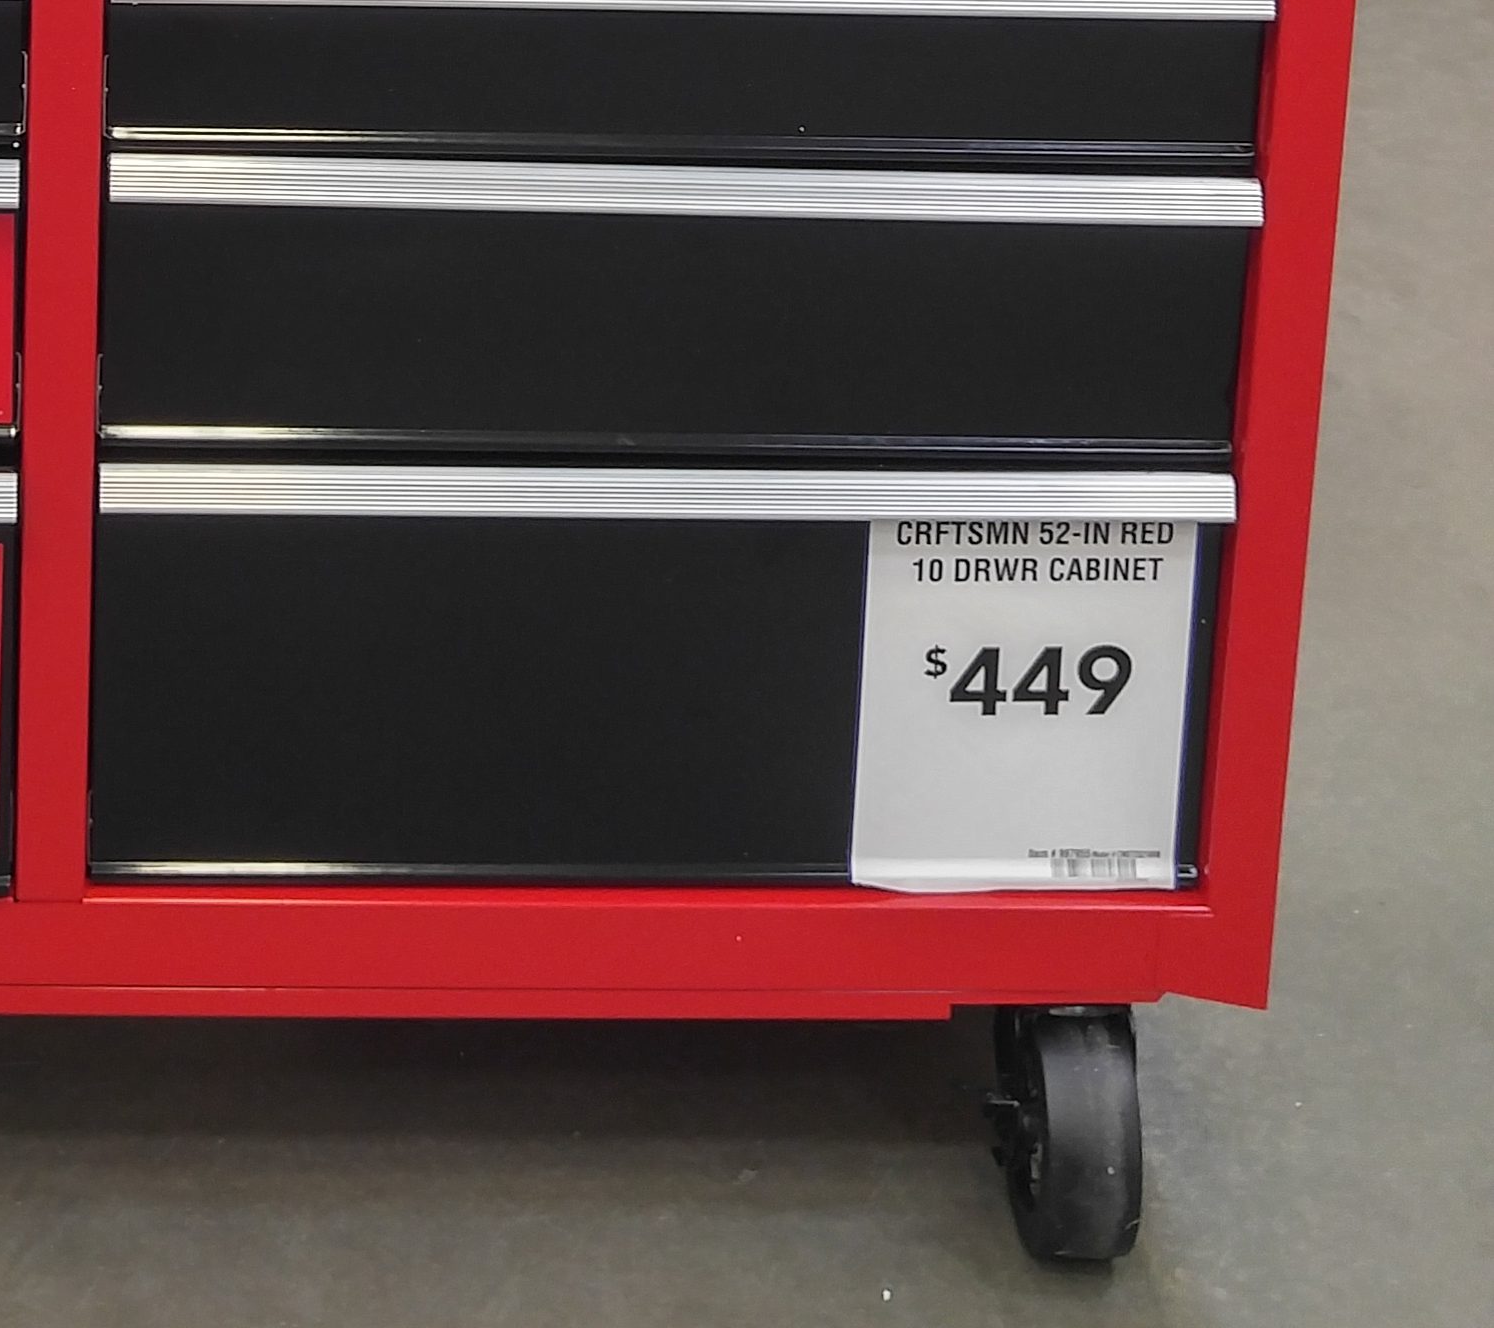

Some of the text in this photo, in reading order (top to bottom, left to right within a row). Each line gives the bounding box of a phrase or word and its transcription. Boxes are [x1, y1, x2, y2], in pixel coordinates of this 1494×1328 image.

[897, 521, 1175, 545] CRFTSMN 52-IN RED
[912, 558, 1164, 582] 10 DRWR CABINET
[924, 644, 1133, 716] $449
